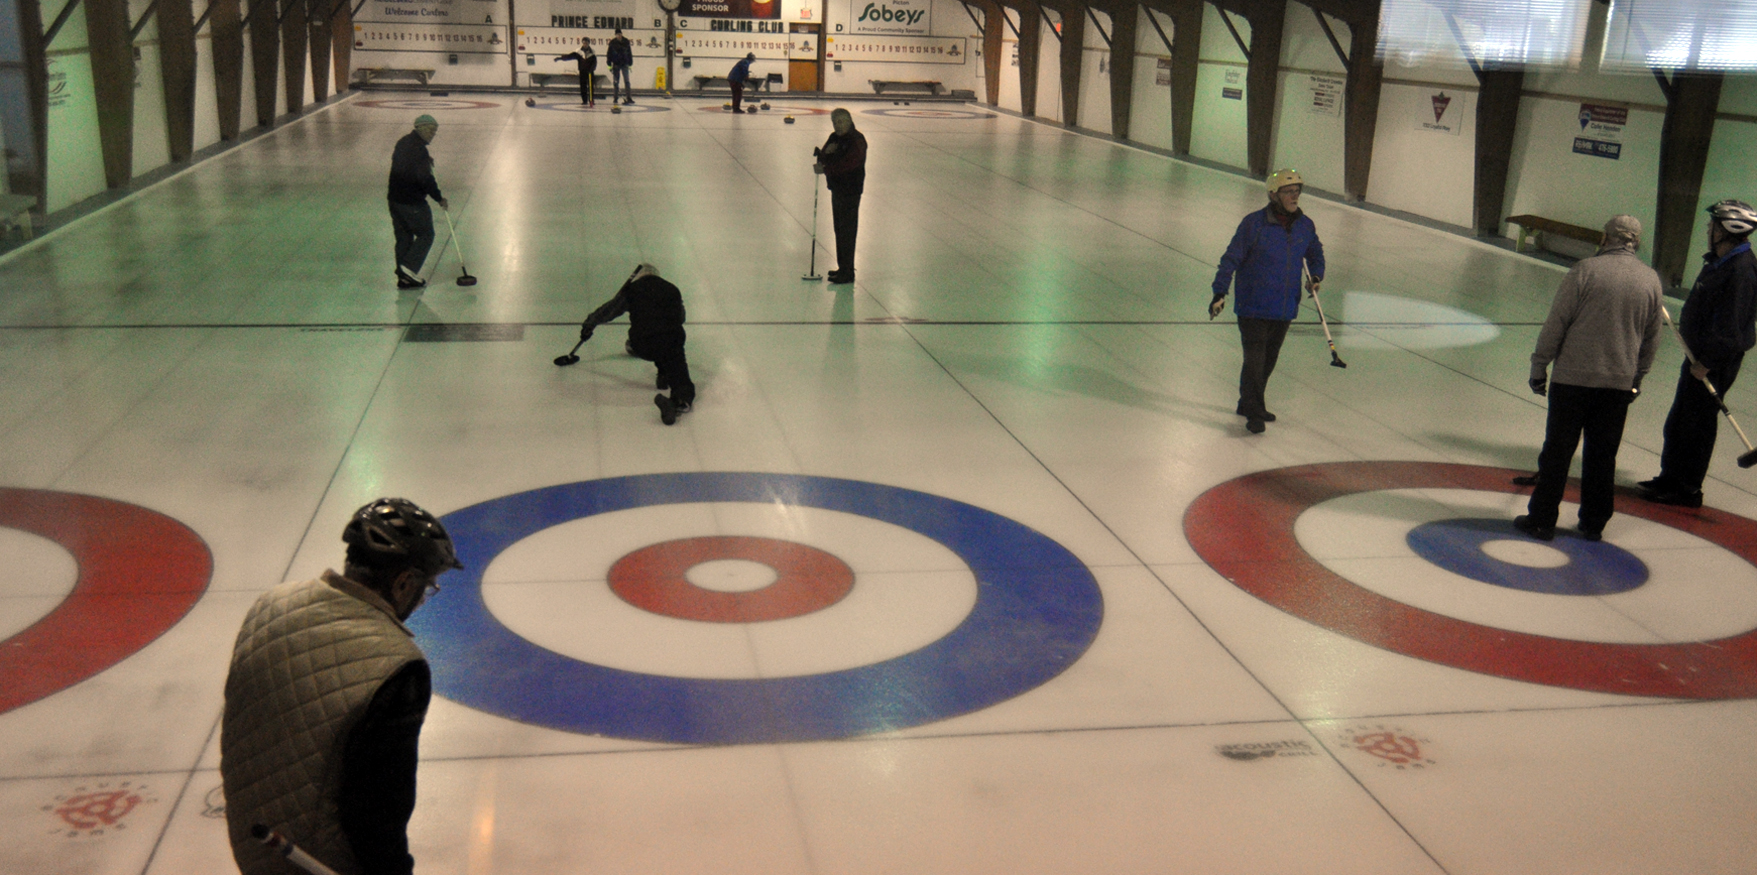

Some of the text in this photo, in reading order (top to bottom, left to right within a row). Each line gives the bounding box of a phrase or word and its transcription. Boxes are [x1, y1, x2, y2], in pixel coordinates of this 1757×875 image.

[385, 7, 419, 16] Welcome
[691, 4, 729, 12] SPONSOR
[858, 2, 925, 25] Sobeys
[485, 15, 492, 23] A
[551, 15, 634, 29] PRINCE EDWARD
[654, 19, 662, 27] B
[680, 20, 688, 28] C
[711, 19, 783, 33] CURLING CLUB
[835, 24, 843, 32] D
